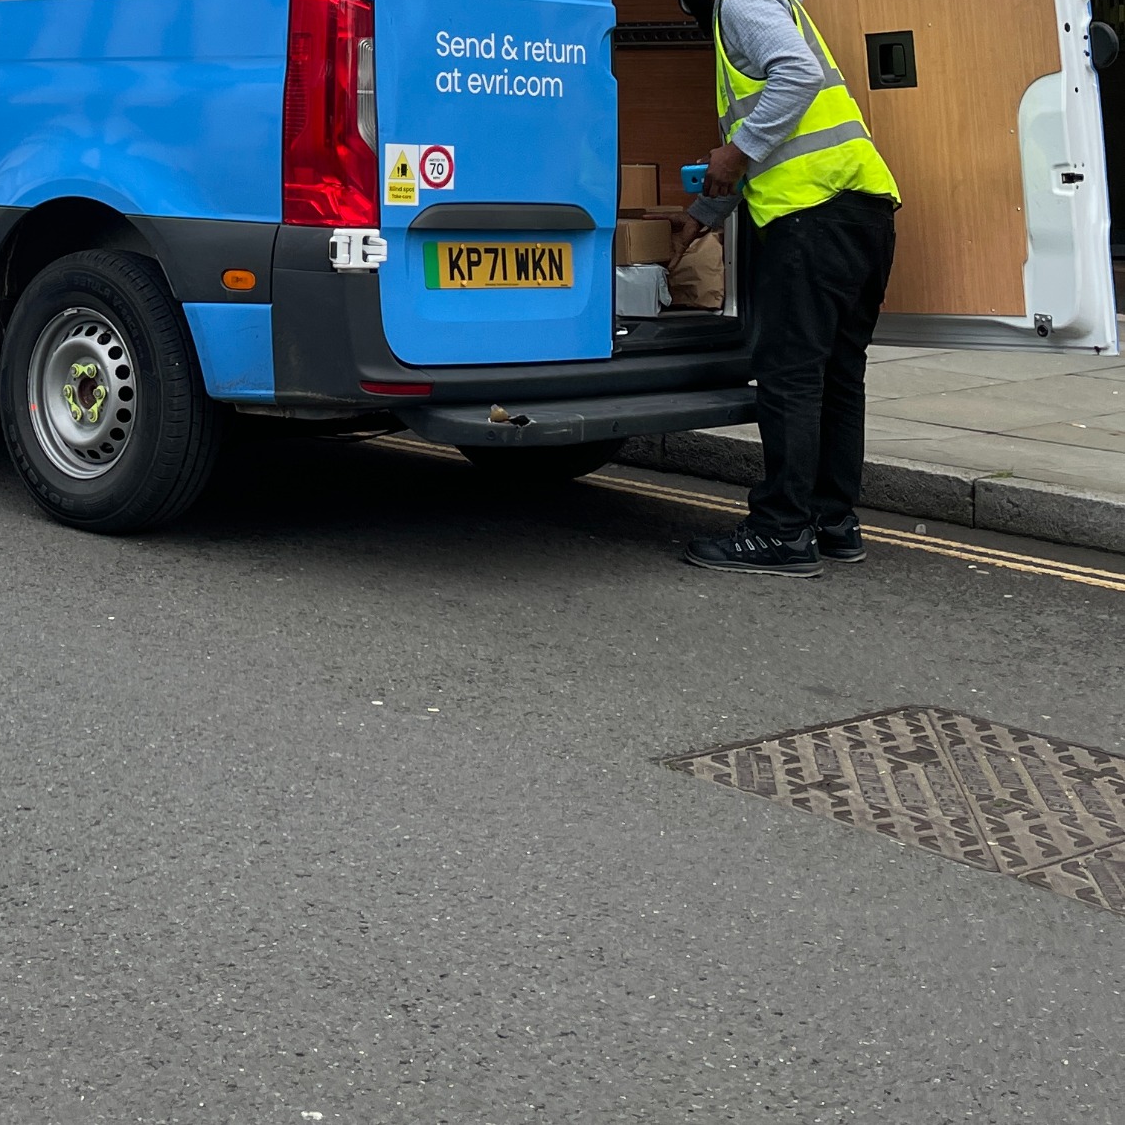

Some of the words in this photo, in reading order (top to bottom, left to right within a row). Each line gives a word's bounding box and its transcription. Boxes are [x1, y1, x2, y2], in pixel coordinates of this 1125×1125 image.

[436, 31, 495, 59] Send
[502, 35, 518, 60] &
[524, 38, 586, 65] return
[436, 68, 462, 93] at
[467, 68, 563, 97] evri.com
[430, 163, 444, 175] 70
[447, 247, 508, 281] KP71
[515, 248, 563, 281] WKN
